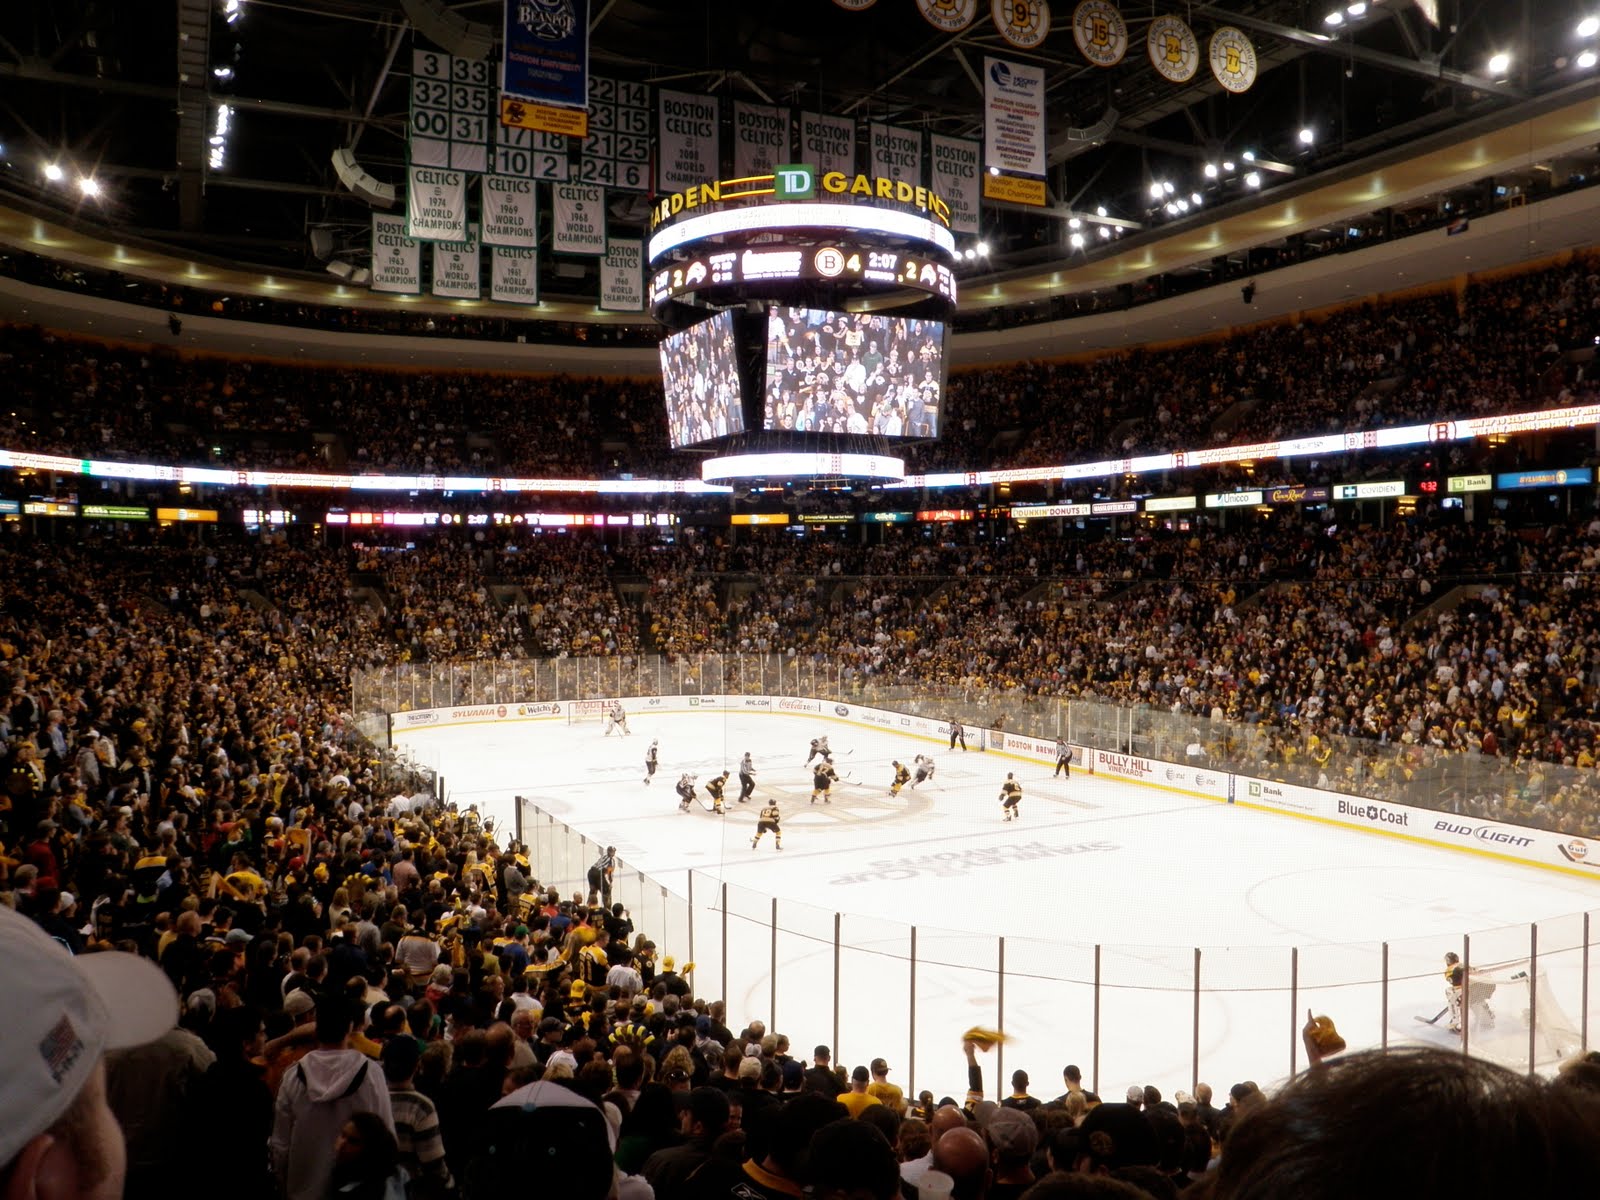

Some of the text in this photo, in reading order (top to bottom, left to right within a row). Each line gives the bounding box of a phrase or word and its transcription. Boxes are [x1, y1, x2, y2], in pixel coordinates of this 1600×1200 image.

[518, 5, 578, 34] BEANPOT
[1015, 5, 1026, 22] 9
[1094, 23, 1107, 40] 15
[1167, 43, 1179, 55] 24
[423, 54, 439, 76] 3
[1227, 54, 1238, 67] 77
[454, 57, 487, 85] 33
[1014, 77, 1038, 86] HOCKEY
[416, 80, 447, 106] 32
[454, 84, 487, 111] 35
[622, 83, 646, 107] 14
[664, 99, 714, 121] BOSTON
[991, 103, 1040, 117] BOSTON UNIVERSITY
[414, 110, 447, 134] 00
[457, 116, 484, 140] 31
[622, 109, 646, 133] 15
[665, 117, 713, 139] CELTICS
[739, 112, 785, 132] BOSTON
[741, 128, 784, 147] CELTICS
[806, 121, 850, 142] BOSTON
[586, 133, 612, 156] 21
[619, 136, 648, 161] 25
[807, 138, 849, 157] CELTICS
[875, 133, 918, 153] BOSTON
[876, 149, 917, 168] CELTICS
[936, 144, 976, 164] BOSTON
[500, 150, 527, 174] 10
[543, 155, 558, 177] 2
[674, 160, 705, 174] WORLD
[937, 159, 976, 179] CELTICS
[415, 170, 460, 187] CELTICS
[584, 159, 612, 184] 24
[626, 165, 640, 187] 6
[666, 171, 715, 186] CHAMPIONS
[488, 178, 531, 194] CELTICS
[779, 170, 811, 193] TD
[823, 171, 940, 214] GARDEN
[559, 187, 600, 202] CELTICS
[429, 197, 446, 208] 1974
[500, 204, 519, 215] 1969
[422, 208, 453, 219] WORLD
[496, 215, 525, 226] WORLD
[571, 213, 589, 223] 1968
[413, 218, 463, 231] CHAMPIONS
[486, 225, 534, 239] CHAMPIONS
[566, 222, 594, 233] WORLD
[378, 235, 416, 250] CELTICS
[438, 238, 476, 252] CELTICS
[558, 232, 603, 246] CHAMPIONS
[497, 248, 533, 259] CELTICS
[608, 246, 640, 258] OSTON
[389, 257, 405, 267] 1963
[449, 262, 464, 272] 1962
[605, 257, 638, 269] CELTICS
[847, 254, 861, 273] 4
[869, 251, 898, 270] 2:07
[384, 266, 410, 277] WORLD
[445, 271, 470, 282] WORLD
[674, 269, 683, 287] 2
[906, 261, 917, 280] 2
[375, 275, 418, 287] CHAMPIONS
[436, 281, 477, 292] CHAMPIONS
[503, 277, 528, 287] WORLD
[494, 285, 535, 297] CHAMPIONS
[611, 286, 633, 296] WORLD
[603, 294, 641, 304] CHAMPIONS
[1361, 485, 1397, 495] COVIDIEN
[1467, 478, 1487, 487] Bank
[1223, 493, 1249, 504] Unicco
[467, 513, 489, 524] 2:07
[875, 512, 897, 521] Gillette
[1018, 505, 1080, 517] DUNKIN' DONUTS
[452, 708, 495, 718] SYLVANIA
[527, 705, 552, 716] Welch's
[938, 727, 952, 736] BUD
[1007, 739, 1033, 751] BOSTON
[1099, 752, 1130, 768] BULLY
[1130, 757, 1153, 773] HILL
[1108, 764, 1143, 778] VINEYARDS
[1263, 786, 1283, 797] Bank
[1338, 799, 1366, 818] Blue
[1379, 807, 1409, 827] Coat
[1433, 821, 1536, 849] BUD LIGHT
[868, 841, 1049, 869] PLAYOFFS
[1567, 843, 1588, 856] Gulf
[828, 841, 1121, 886] STANLEY CUP
